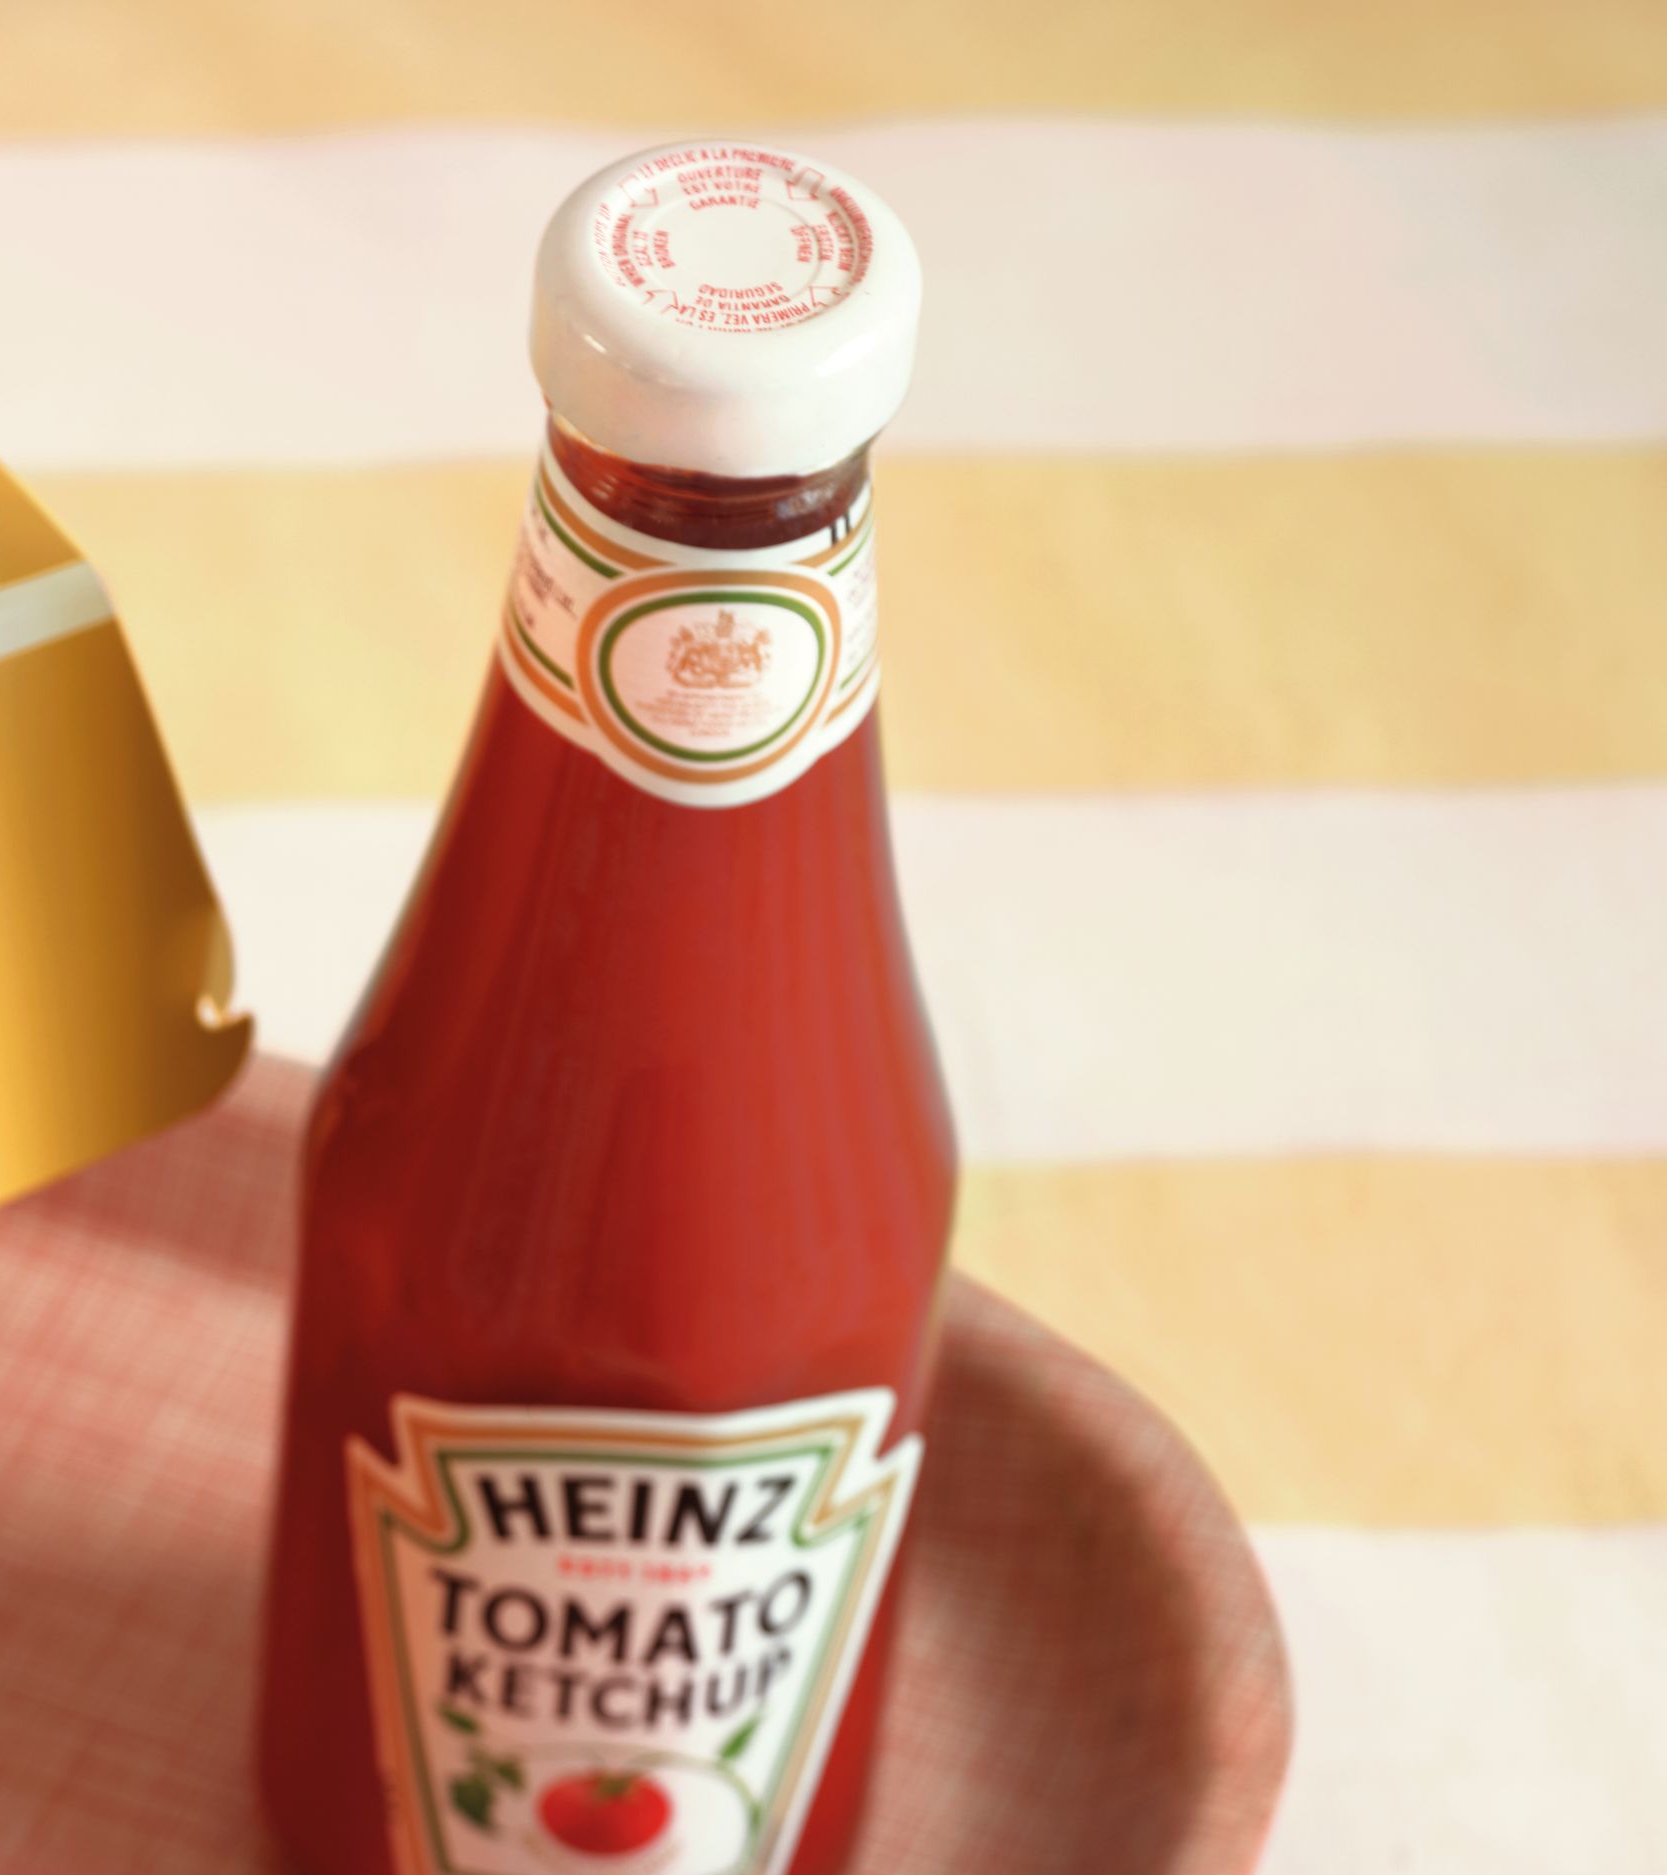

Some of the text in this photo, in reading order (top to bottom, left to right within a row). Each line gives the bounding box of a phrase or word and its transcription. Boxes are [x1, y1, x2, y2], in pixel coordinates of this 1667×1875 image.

[698, 281, 783, 299] SEGURIDAD
[679, 304, 696, 318] LA
[699, 310, 715, 322] ES
[752, 302, 810, 325] PRIMERA
[477, 1473, 799, 1549] HEINZ
[430, 1568, 813, 1670] TOMATO
[446, 1645, 794, 1735] KETCHUP
